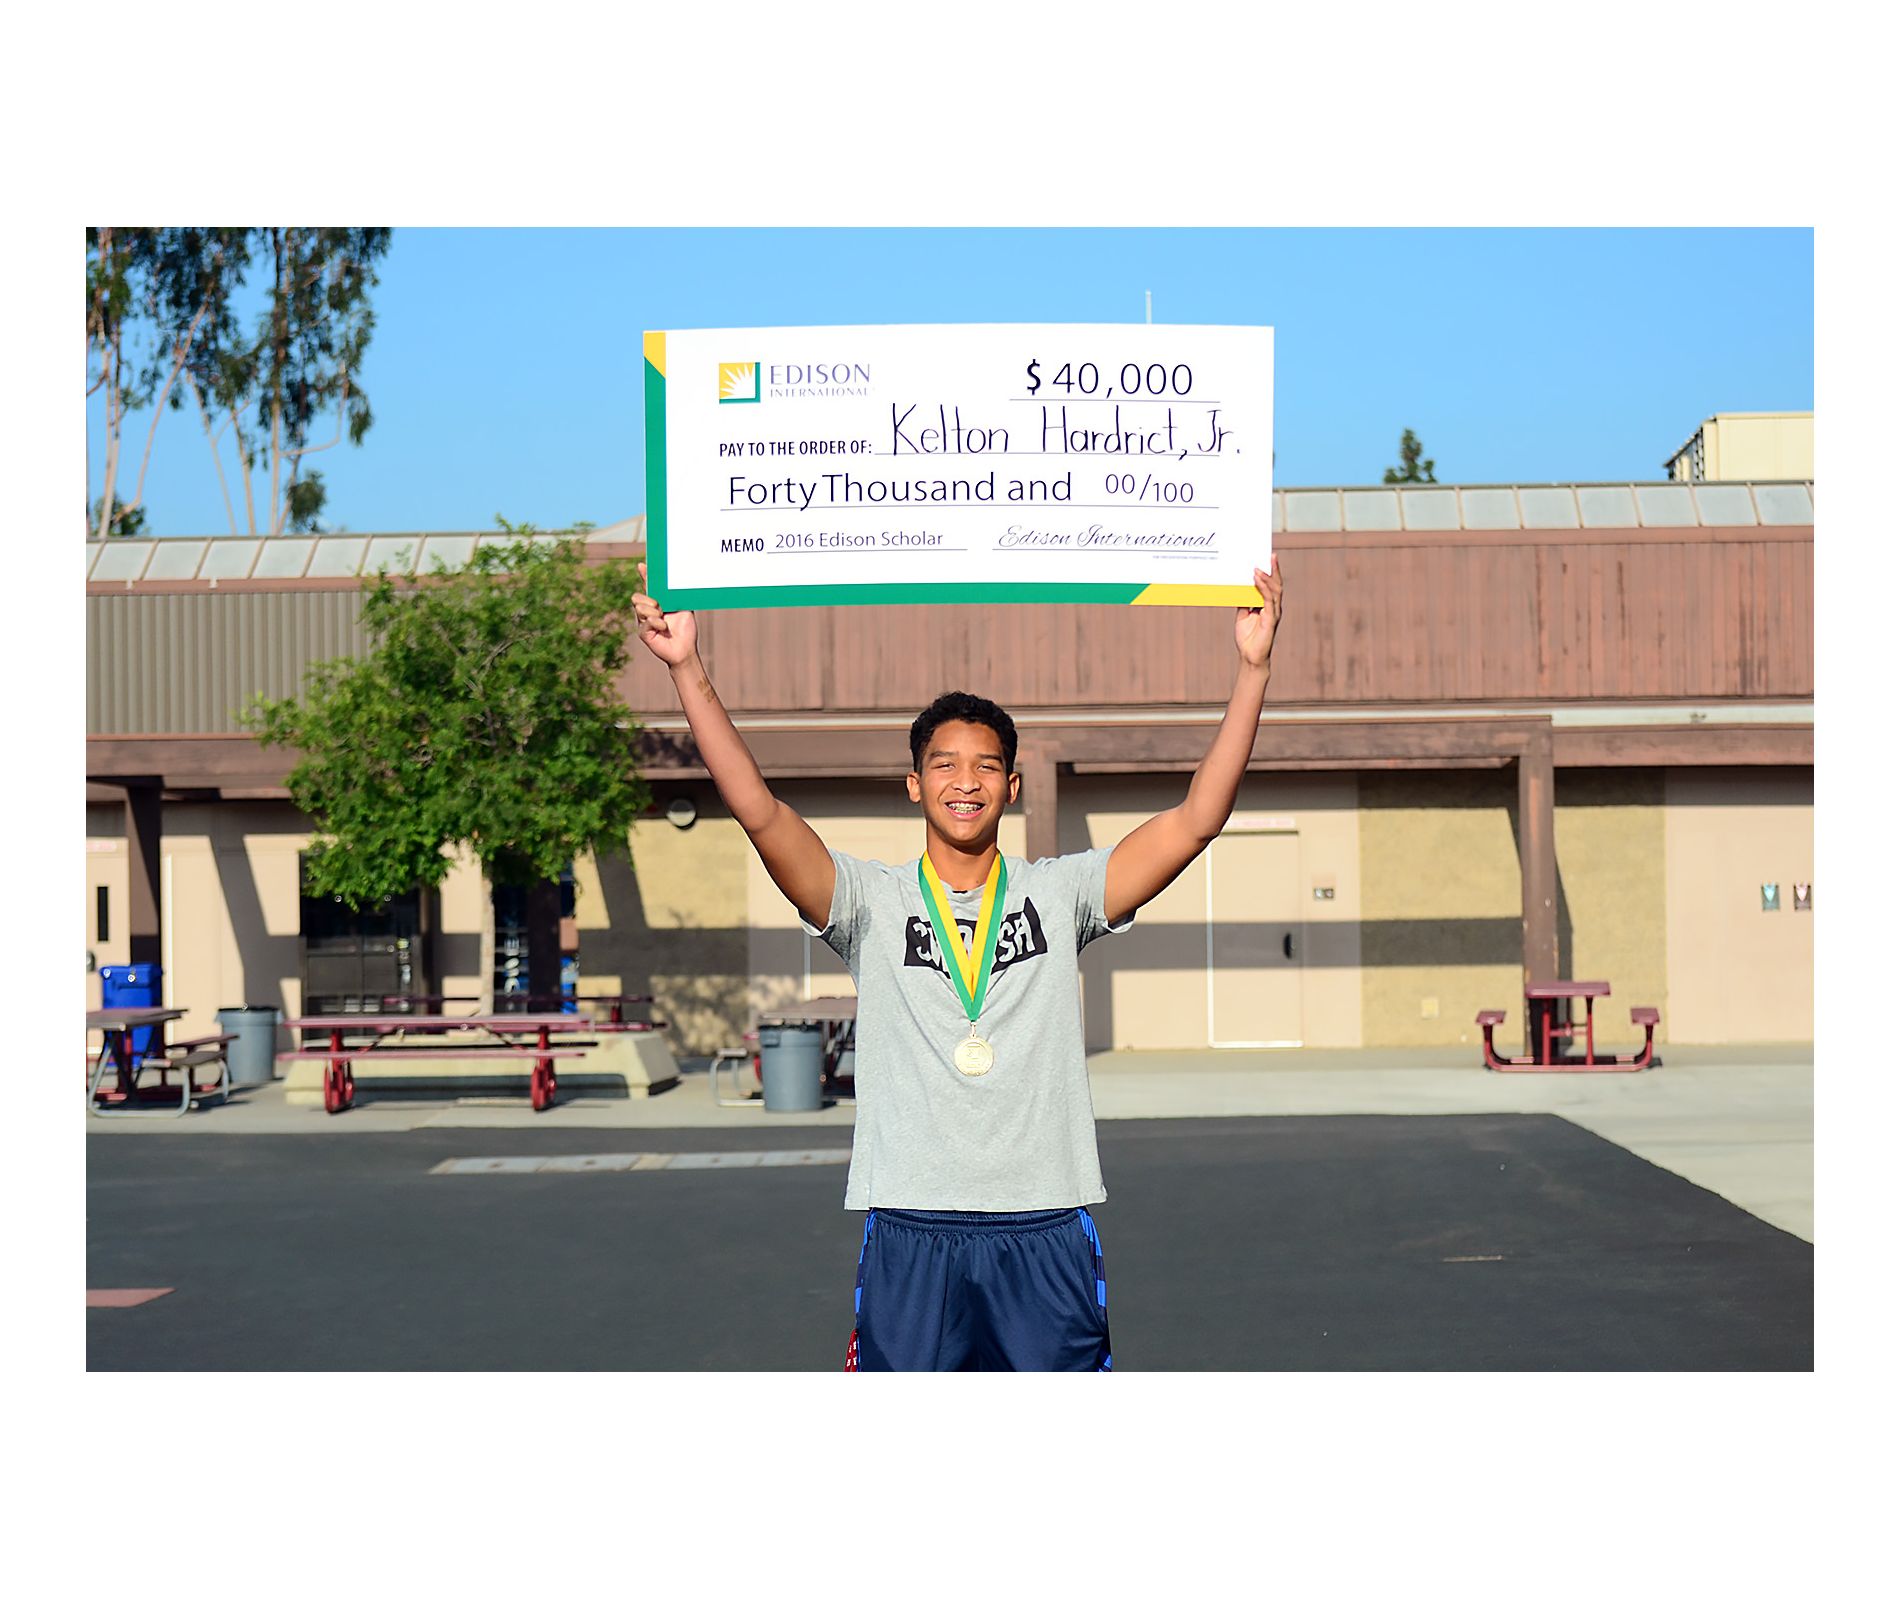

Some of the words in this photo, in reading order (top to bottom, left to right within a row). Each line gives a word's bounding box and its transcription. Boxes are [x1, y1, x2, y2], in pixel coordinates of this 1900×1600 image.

[771, 364, 869, 384] EDISON
[1052, 363, 1192, 398] 40,000
[770, 387, 867, 398] INTERNATIONAL
[893, 402, 1008, 455] Kelton
[1043, 404, 1187, 461] Hardrict,
[1197, 410, 1240, 454] Jr.
[720, 443, 744, 457] PAY
[748, 442, 764, 456] TO
[769, 441, 795, 456] THE
[799, 441, 846, 455] ORDER
[850, 440, 871, 454] OF:
[730, 476, 817, 511] Forty
[822, 472, 994, 502] Thousand
[1008, 472, 1071, 501] and
[1106, 474, 1193, 503] 00/100
[721, 538, 764, 553] MEMO
[776, 534, 814, 548] 2016
[820, 532, 875, 547] Edison
[882, 531, 943, 546] Scholar
[999, 526, 1070, 547] Edison
[1077, 525, 1215, 547] International
